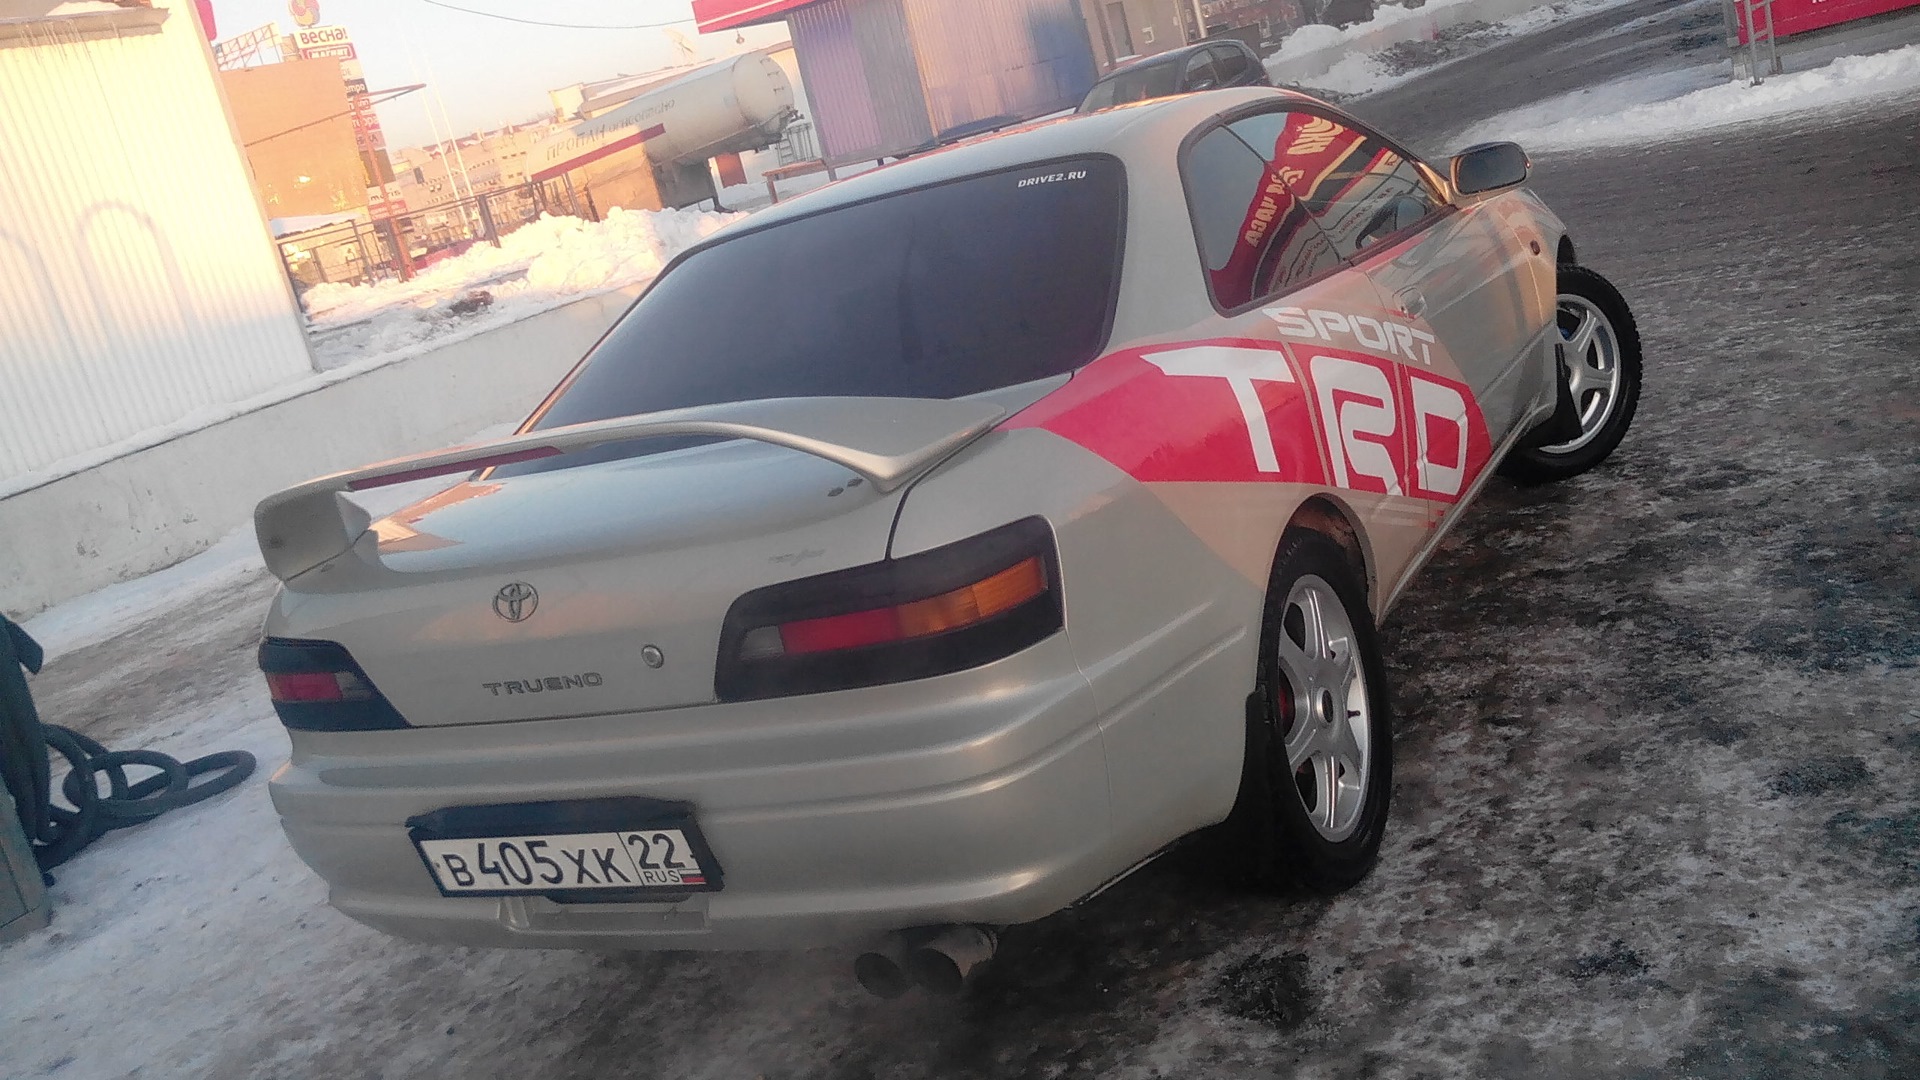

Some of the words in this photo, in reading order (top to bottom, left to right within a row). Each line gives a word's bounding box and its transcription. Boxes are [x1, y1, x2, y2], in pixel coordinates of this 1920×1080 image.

[546, 123, 606, 160] ПРОПАН
[1017, 170, 1087, 188] DRIVE2.RU
[1262, 307, 1435, 365] SPORT
[1140, 346, 1468, 496] TRD
[482, 672, 603, 696] TRUENO
[627, 833, 686, 869] 22
[644, 869, 680, 883] RUS
